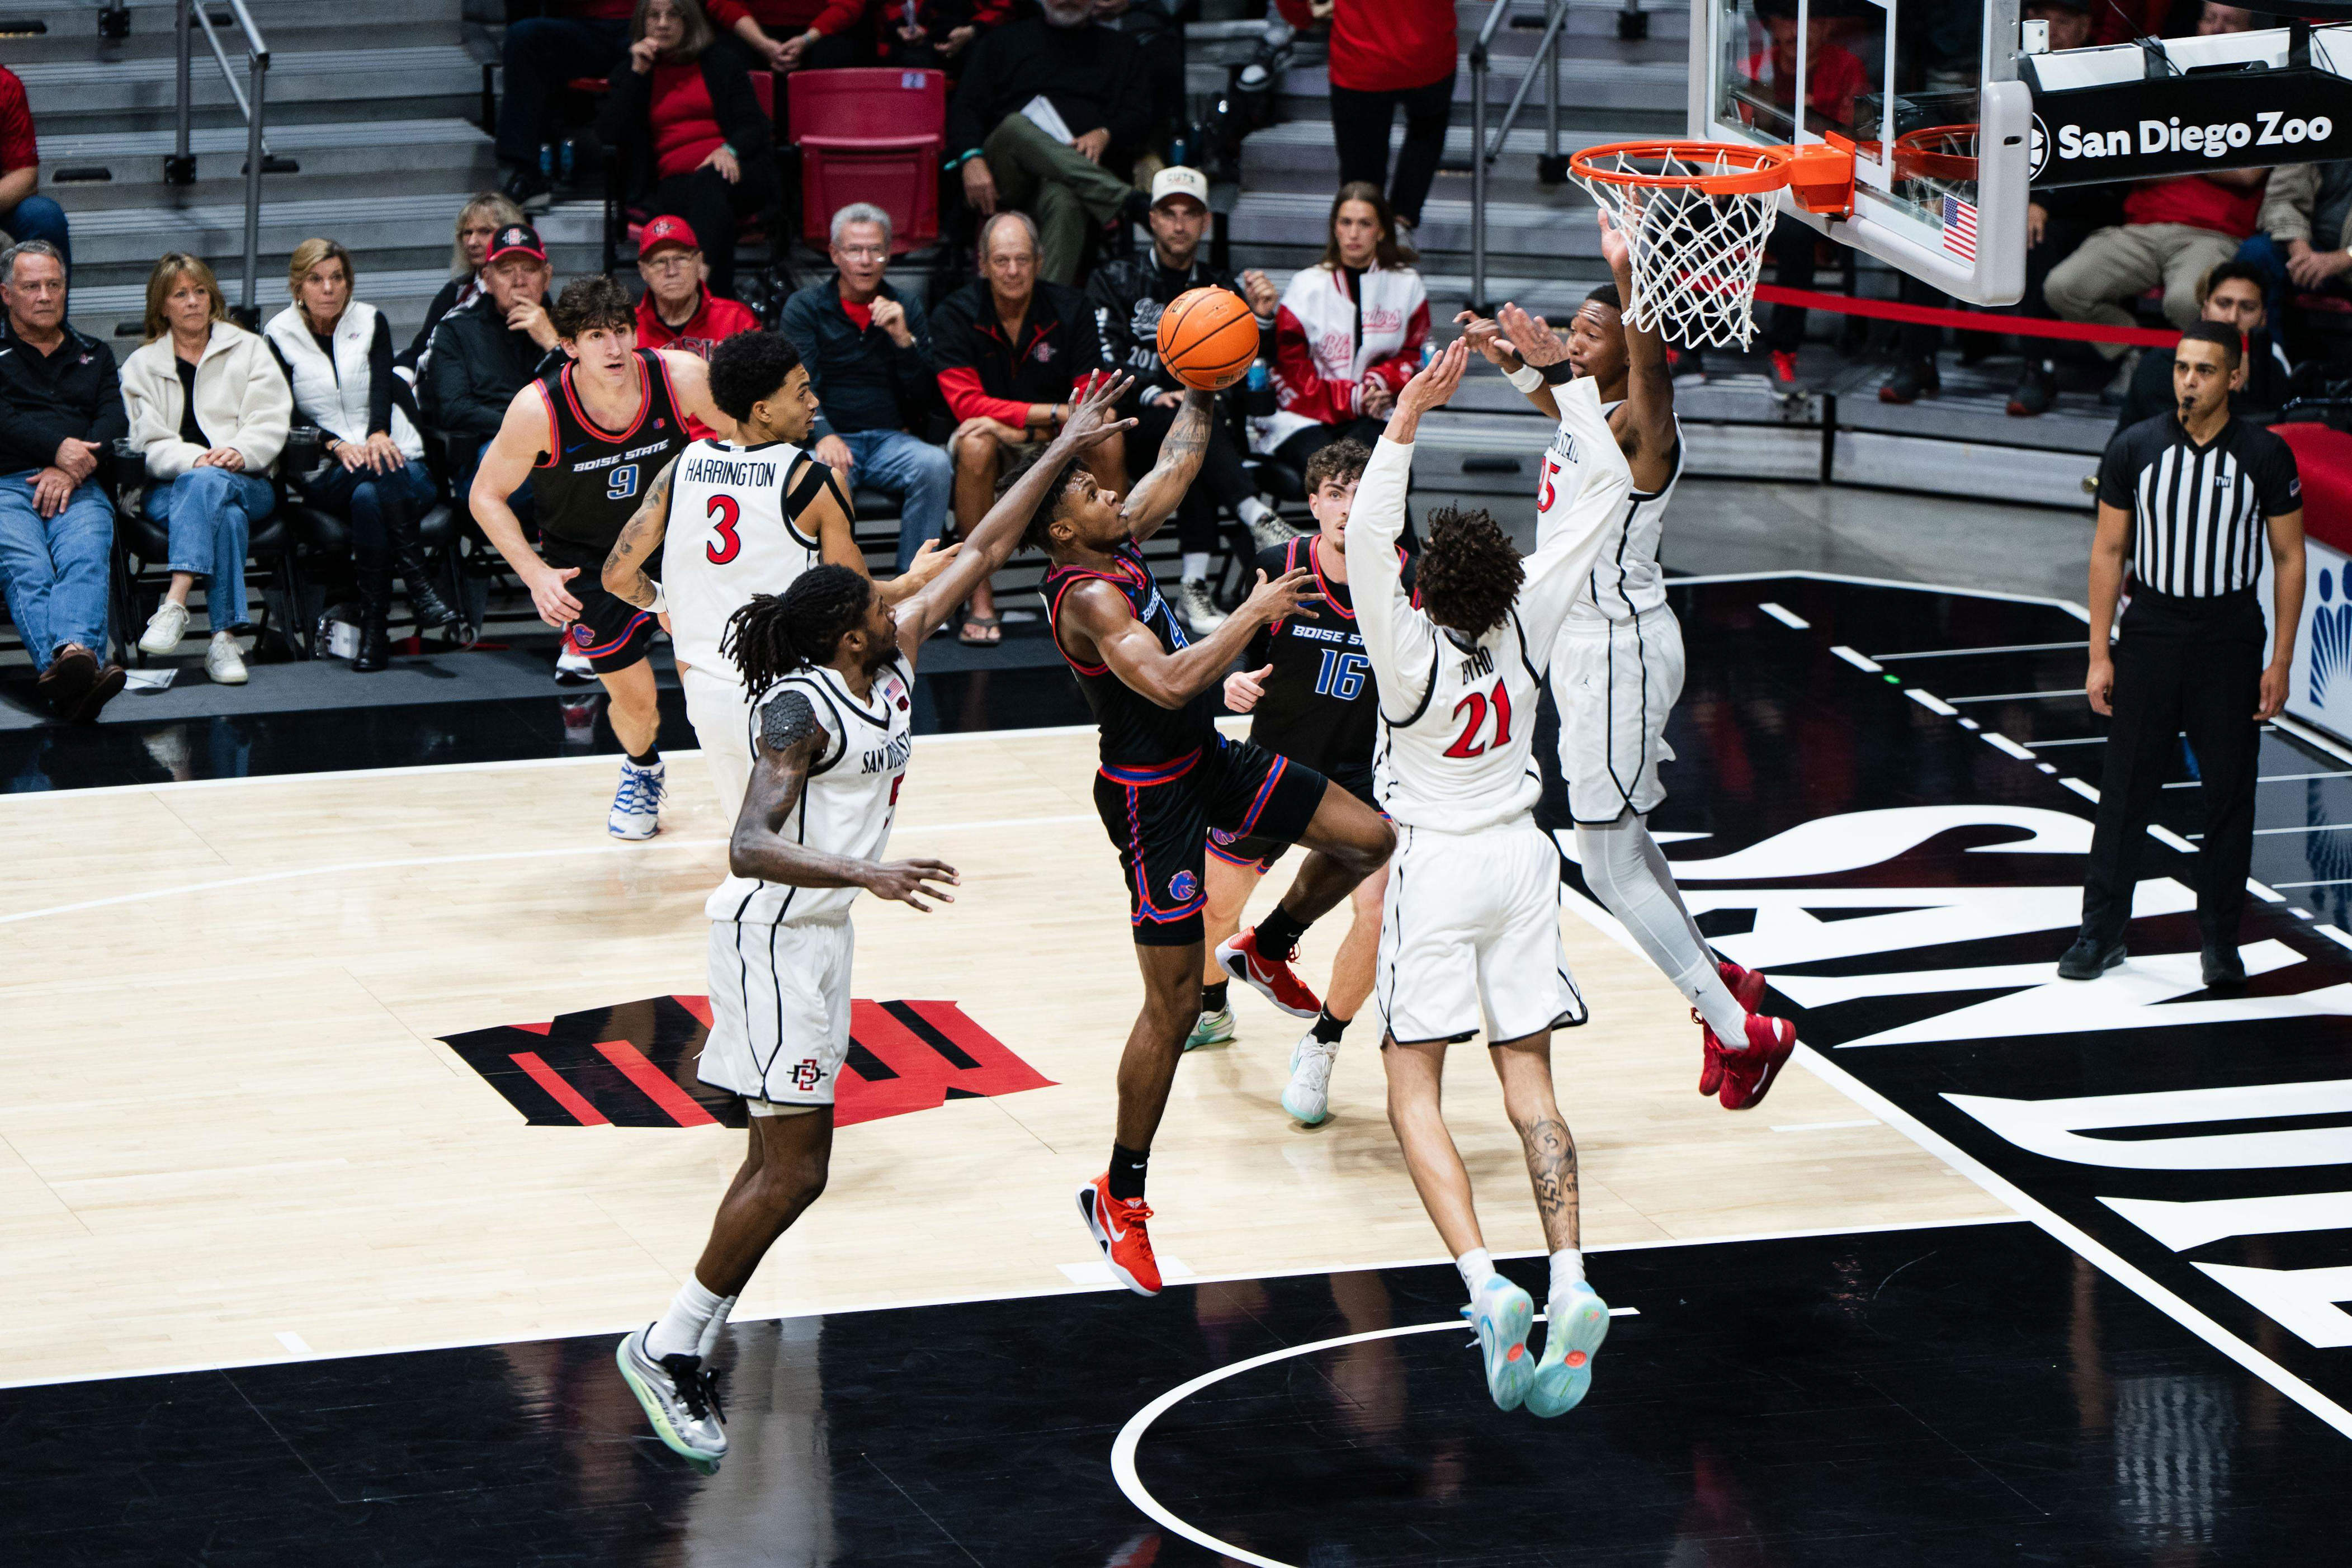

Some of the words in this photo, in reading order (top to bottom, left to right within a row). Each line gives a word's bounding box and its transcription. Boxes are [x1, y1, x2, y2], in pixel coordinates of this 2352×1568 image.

[2058, 125, 2130, 159] San
[2139, 117, 2251, 157] Diego
[2256, 111, 2332, 145] Zoo
[573, 454, 621, 472] BOISE
[624, 438, 669, 461] STATE
[684, 459, 777, 487] HARRINGTON
[607, 464, 640, 499] 9
[706, 494, 741, 565] 3
[1141, 586, 1161, 623] BOISE
[1160, 597, 1191, 649] 4
[1292, 625, 1344, 643] BOISE
[1315, 648, 1370, 701] 16
[1442, 676, 1512, 758] 21
[861, 747, 885, 774] SAN
